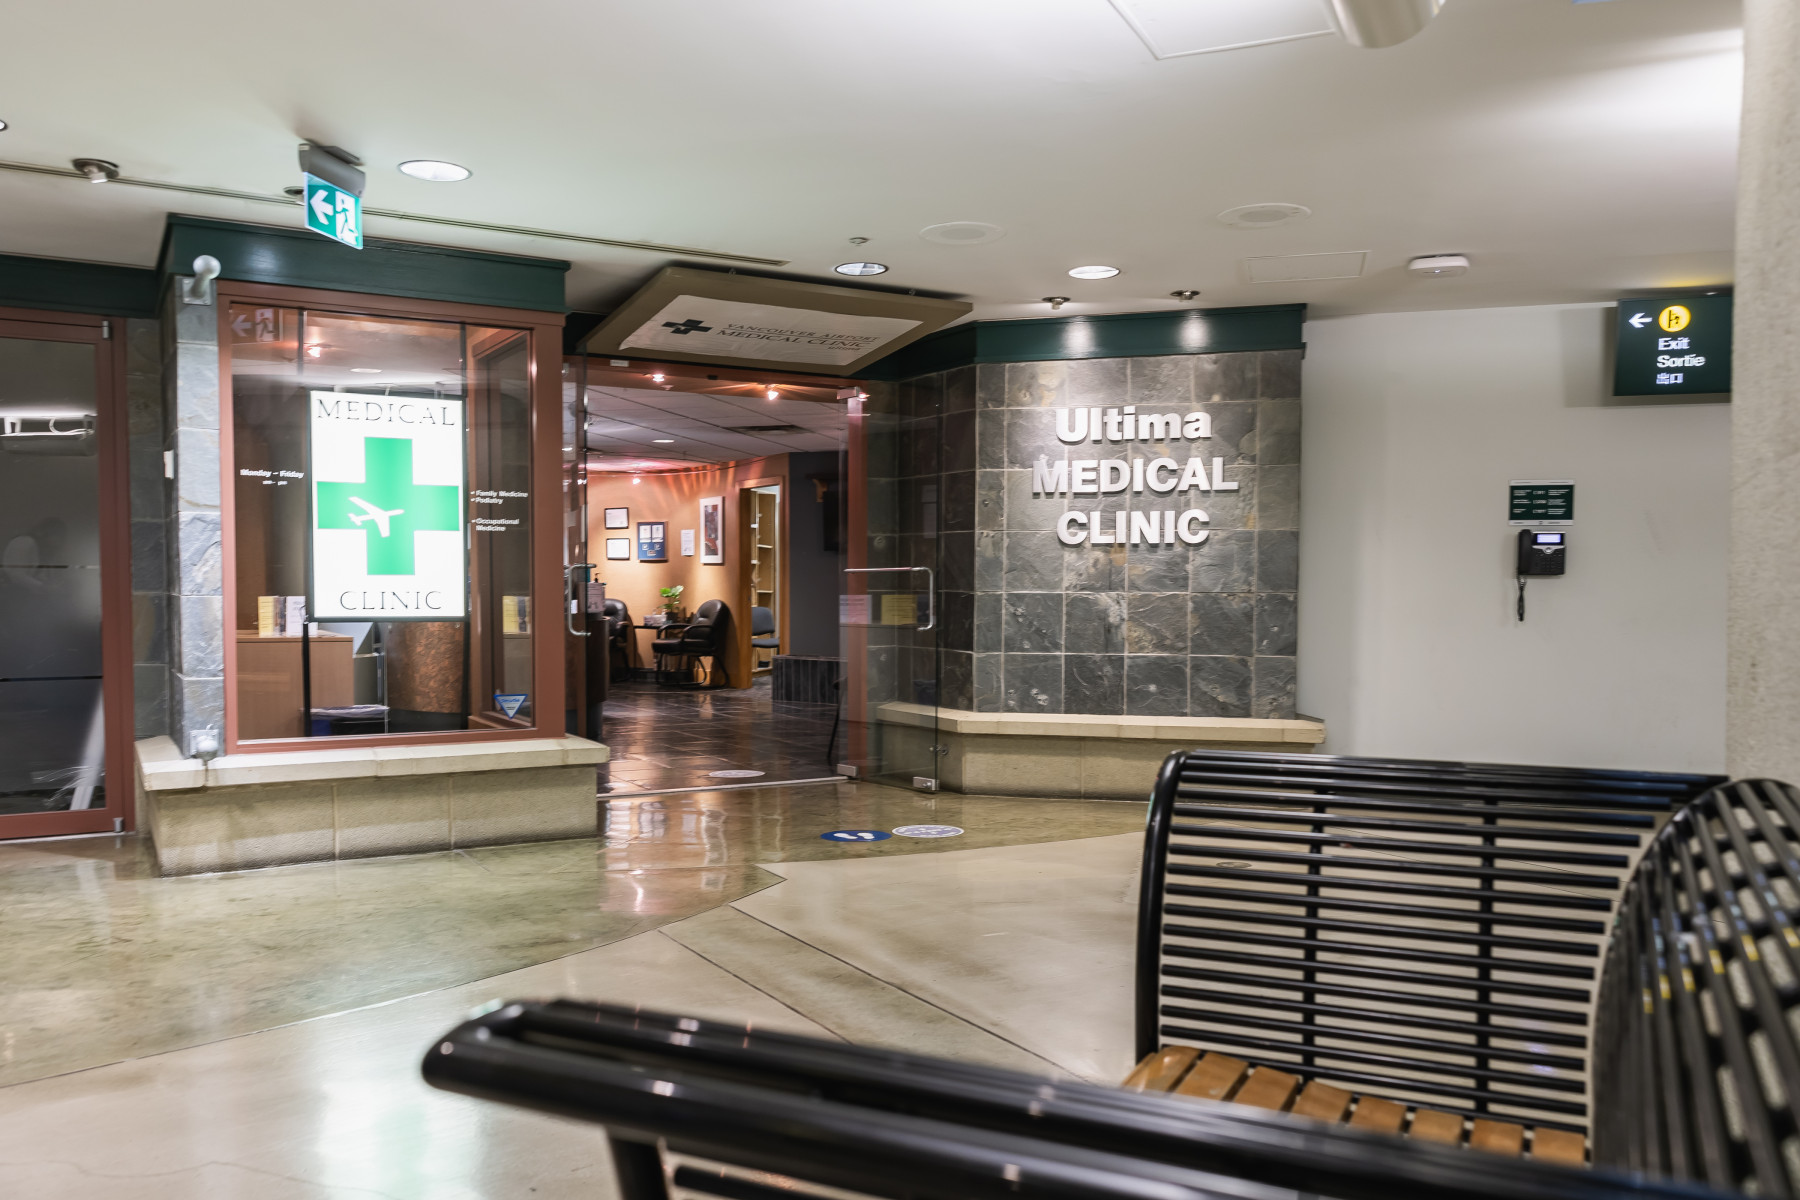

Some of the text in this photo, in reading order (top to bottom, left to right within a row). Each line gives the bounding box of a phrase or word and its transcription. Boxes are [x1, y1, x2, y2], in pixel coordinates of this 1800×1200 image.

[716, 330, 871, 349] MEDICAL CLINIC
[728, 323, 881, 343] VANCOUVER AIRPORT
[1658, 337, 1691, 350] Exit
[1657, 354, 1706, 368] Sortie
[316, 398, 456, 426] MEDICAL
[1055, 406, 1213, 443] Ultima
[240, 469, 272, 477] Monday
[280, 470, 304, 478] Friday
[1032, 457, 1240, 493] MEDICAL
[1057, 508, 1211, 544] CLINIC
[339, 590, 443, 610] CLINIC
